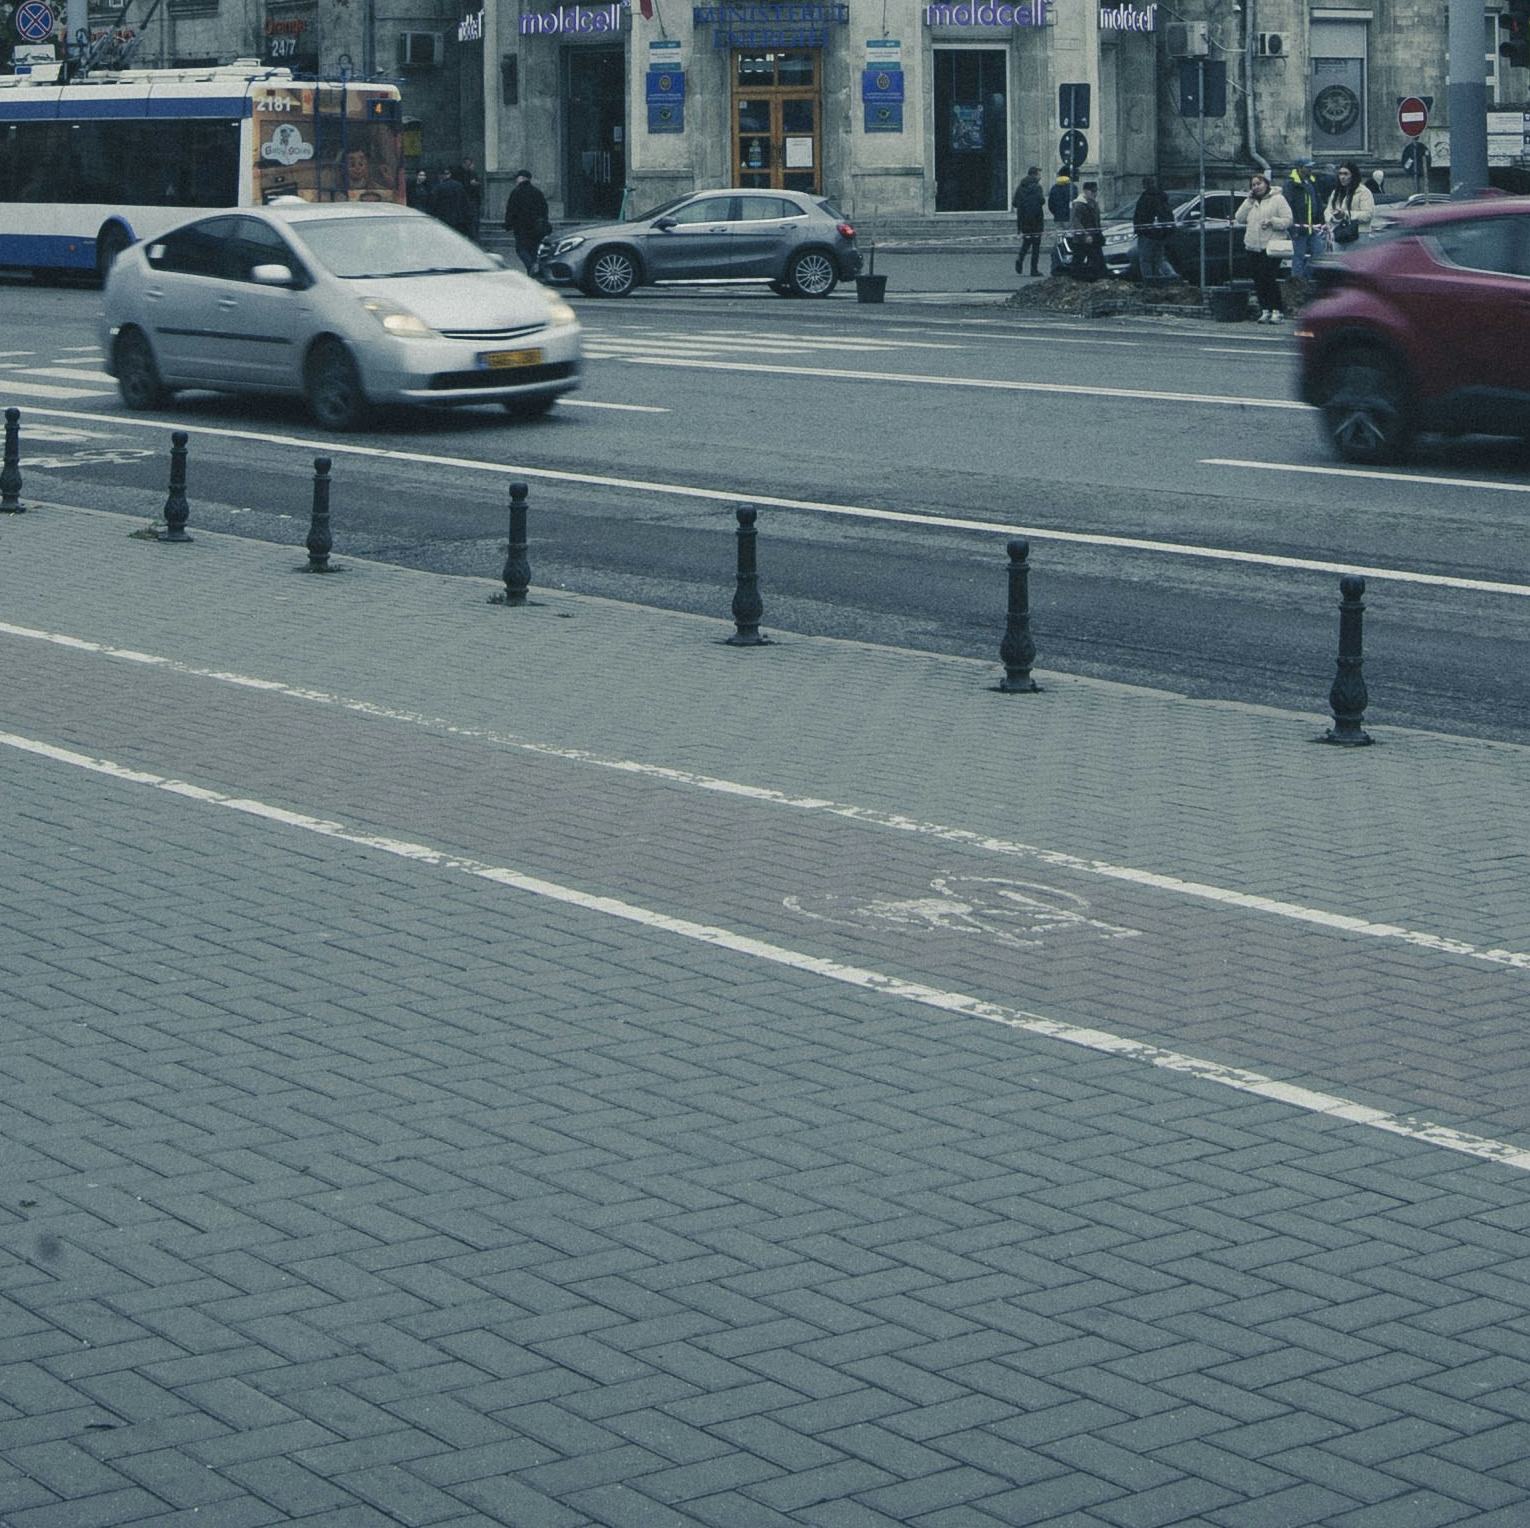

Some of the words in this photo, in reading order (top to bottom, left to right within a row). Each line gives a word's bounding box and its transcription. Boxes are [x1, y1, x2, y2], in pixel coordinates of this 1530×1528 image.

[520, 5, 621, 34] moldcell
[695, 3, 847, 24] MINISTERUL
[1100, 3, 1155, 32] moldcell
[272, 39, 297, 57] 24/7
[256, 97, 291, 112] 2181
[374, 103, 382, 113] 4
